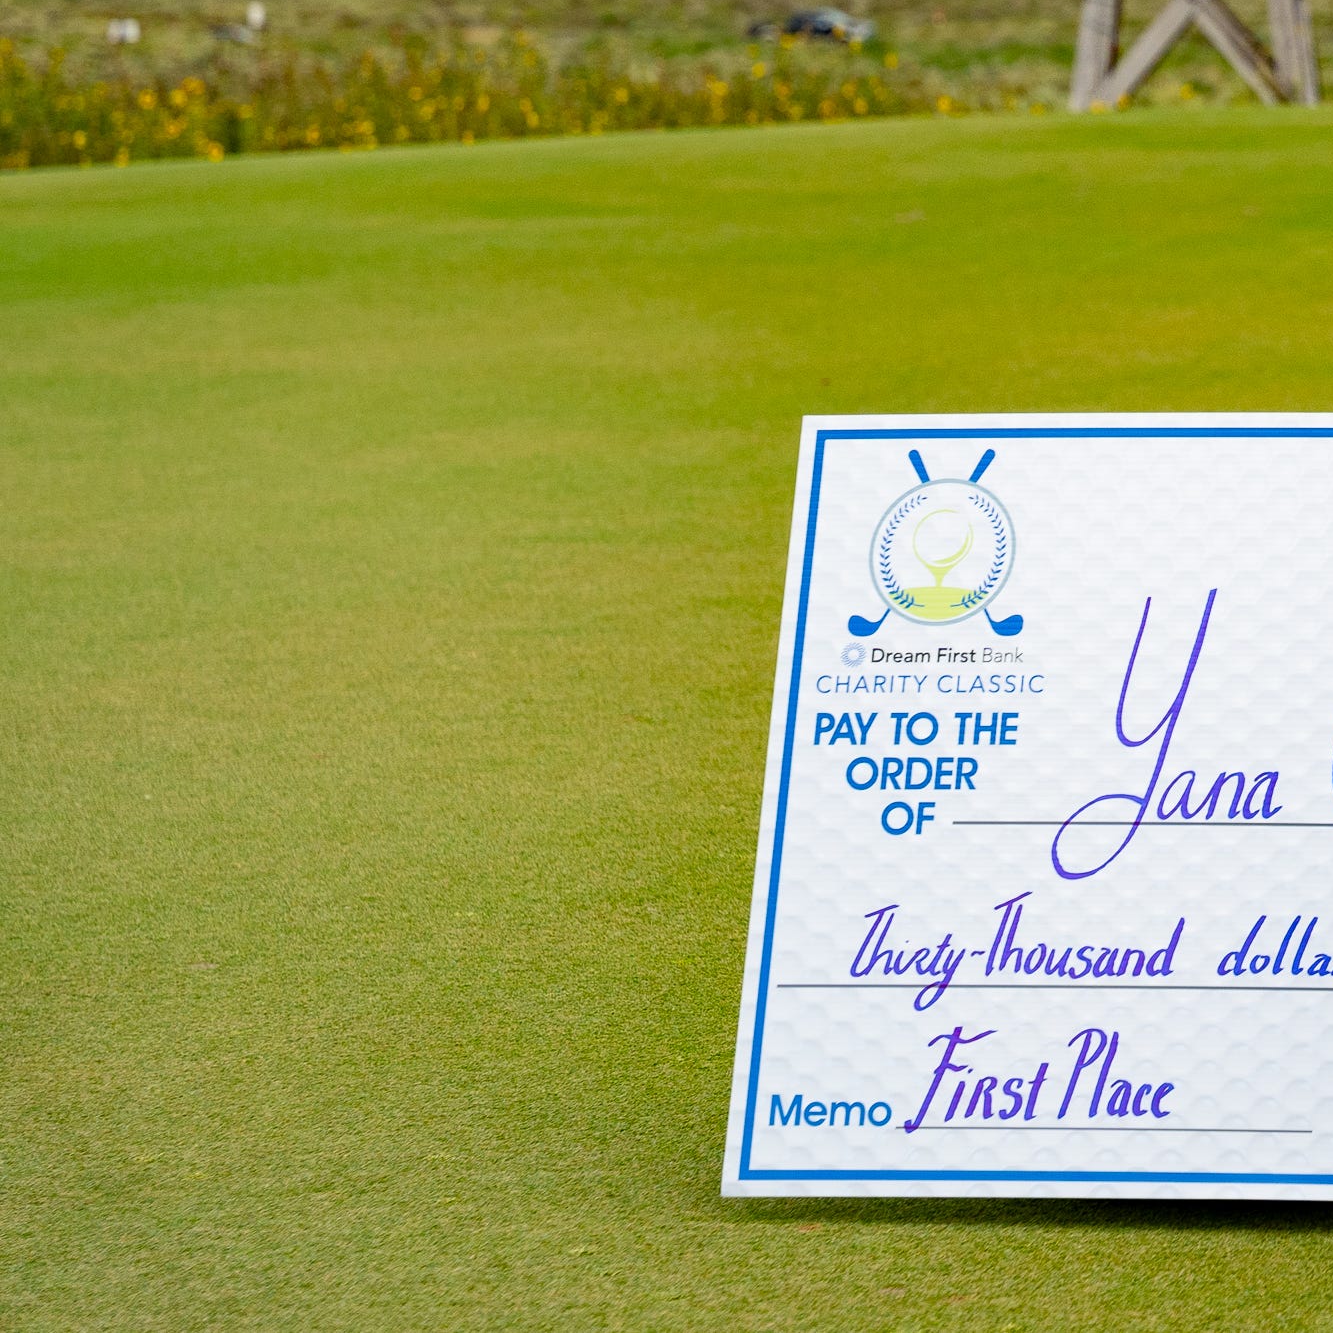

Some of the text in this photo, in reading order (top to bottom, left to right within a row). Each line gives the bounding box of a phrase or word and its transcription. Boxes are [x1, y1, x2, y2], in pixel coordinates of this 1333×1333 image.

[871, 647, 1024, 664] Dream First Bank
[816, 674, 1045, 694] CHARITY CLASSIC
[814, 712, 1019, 746] PAY TO THE
[1051, 588, 1283, 880] Yana
[845, 756, 979, 791] ORDER
[881, 801, 936, 836] OF
[904, 1026, 1176, 1134] First Place
[769, 1094, 892, 1127] Memo
